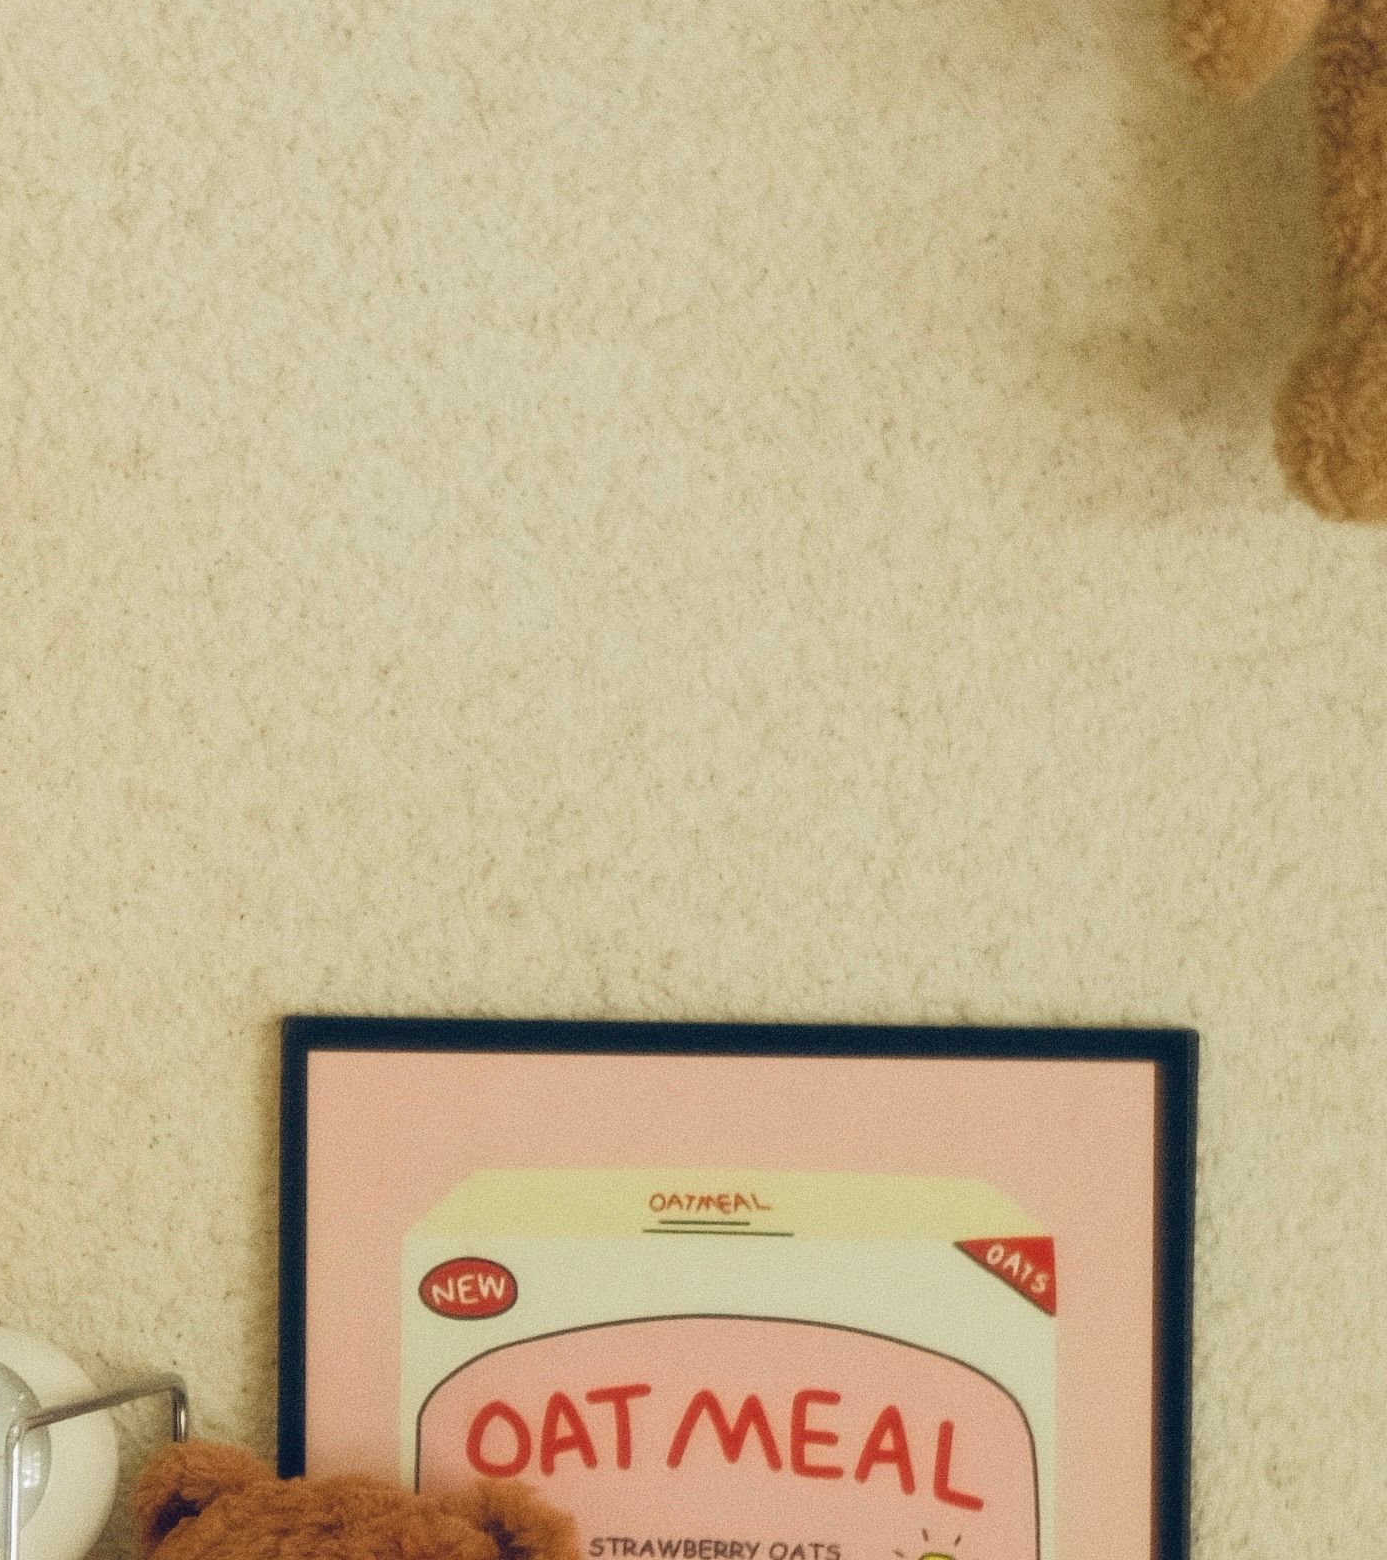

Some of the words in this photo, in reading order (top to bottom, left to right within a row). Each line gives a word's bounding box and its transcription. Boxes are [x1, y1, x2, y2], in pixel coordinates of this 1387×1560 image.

[648, 1193, 772, 1215] OATMEAL
[985, 1243, 1050, 1295] OATS
[431, 1273, 505, 1305] NEW
[465, 1382, 985, 1512] OATMEAL
[588, 1536, 761, 1560] STRAWBERRY
